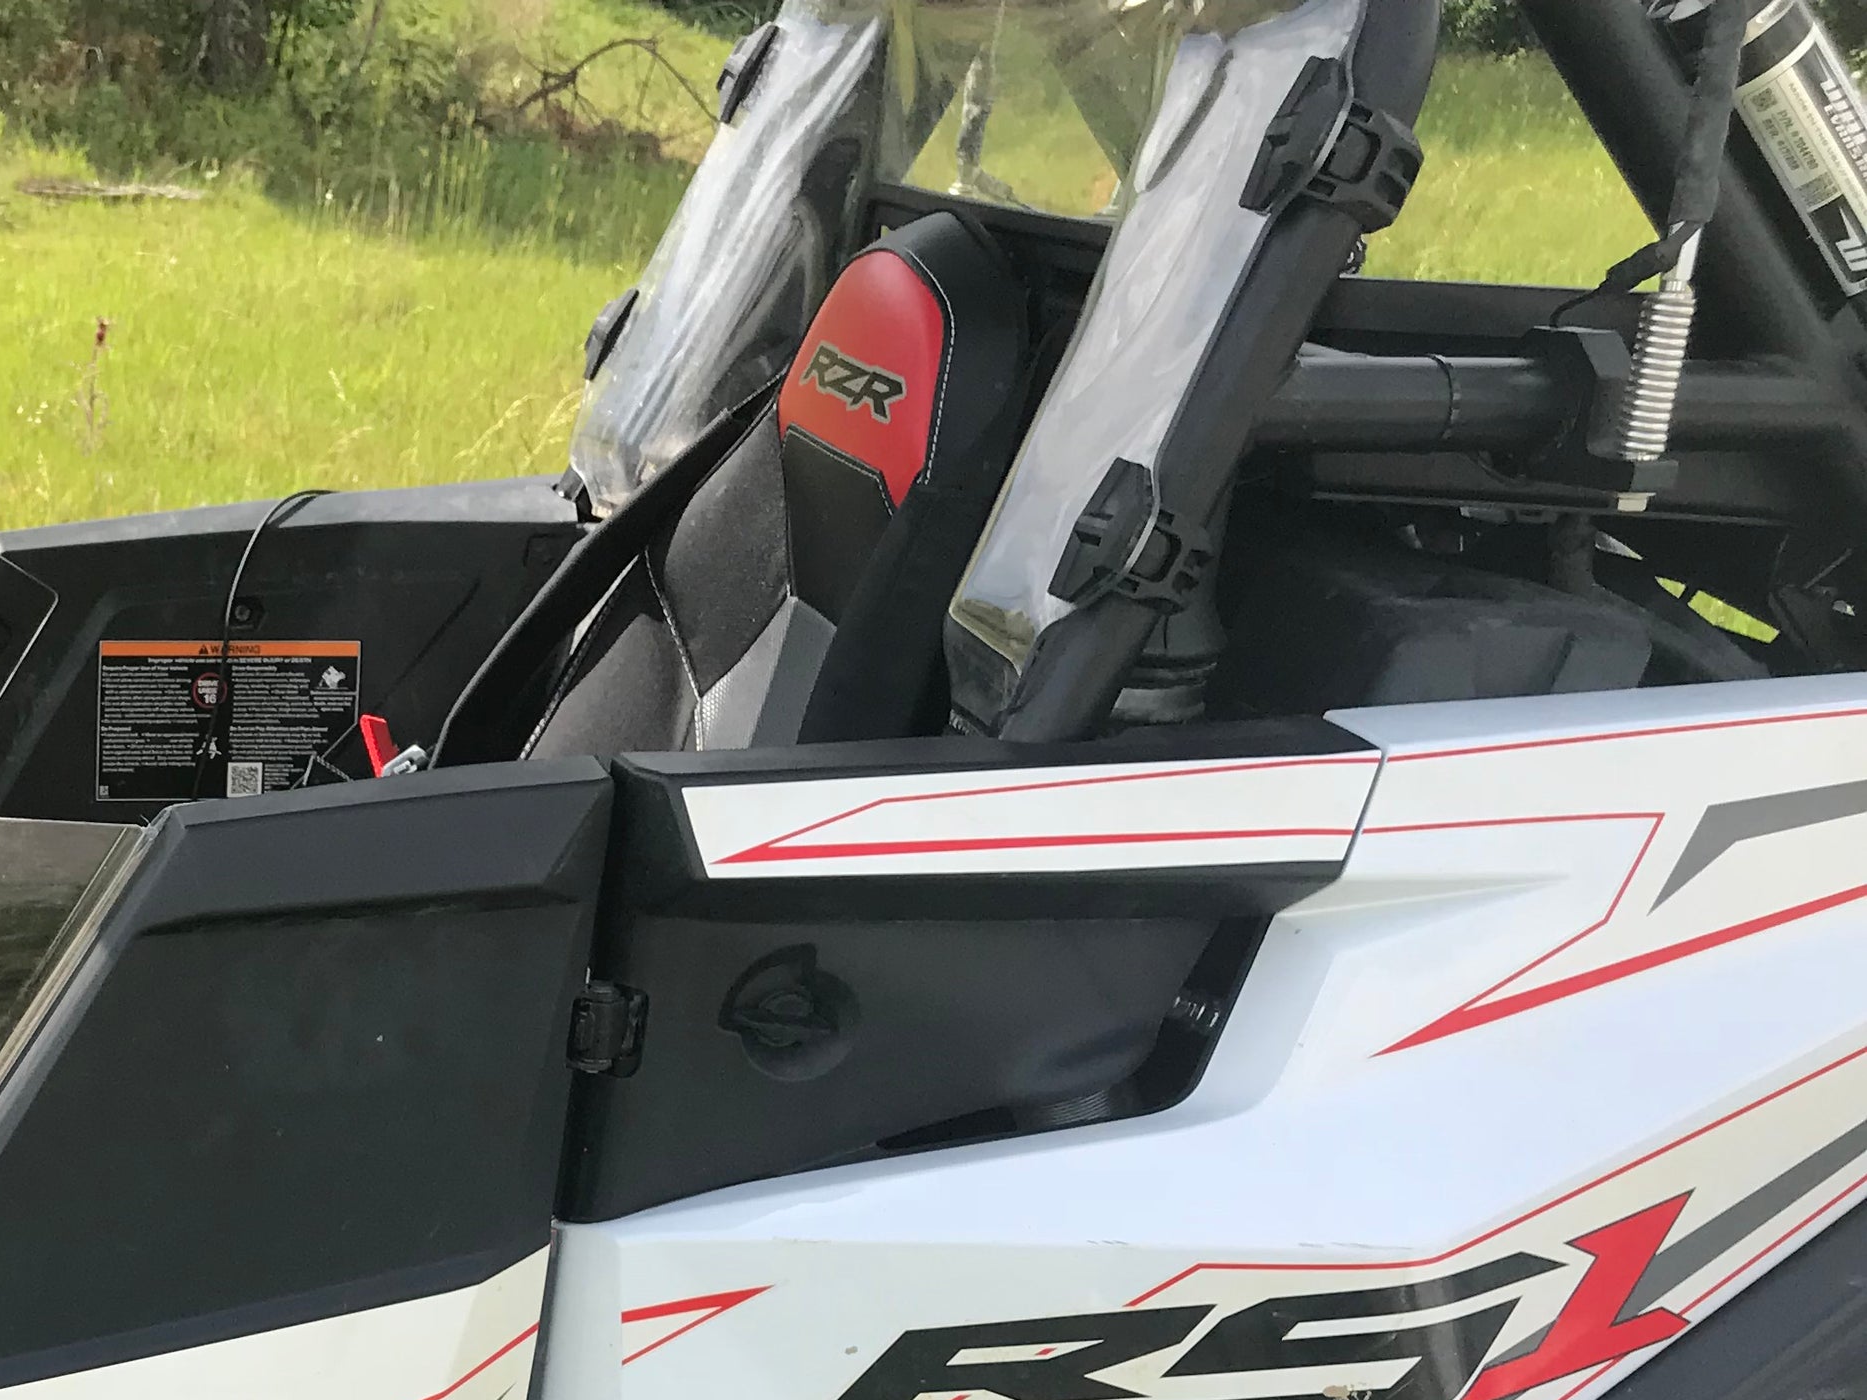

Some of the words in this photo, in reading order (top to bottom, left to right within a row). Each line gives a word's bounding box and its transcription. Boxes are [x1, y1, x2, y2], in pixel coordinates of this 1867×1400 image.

[801, 342, 905, 422] RZR
[210, 645, 261, 654] WRNING
[204, 694, 217, 704] 16
